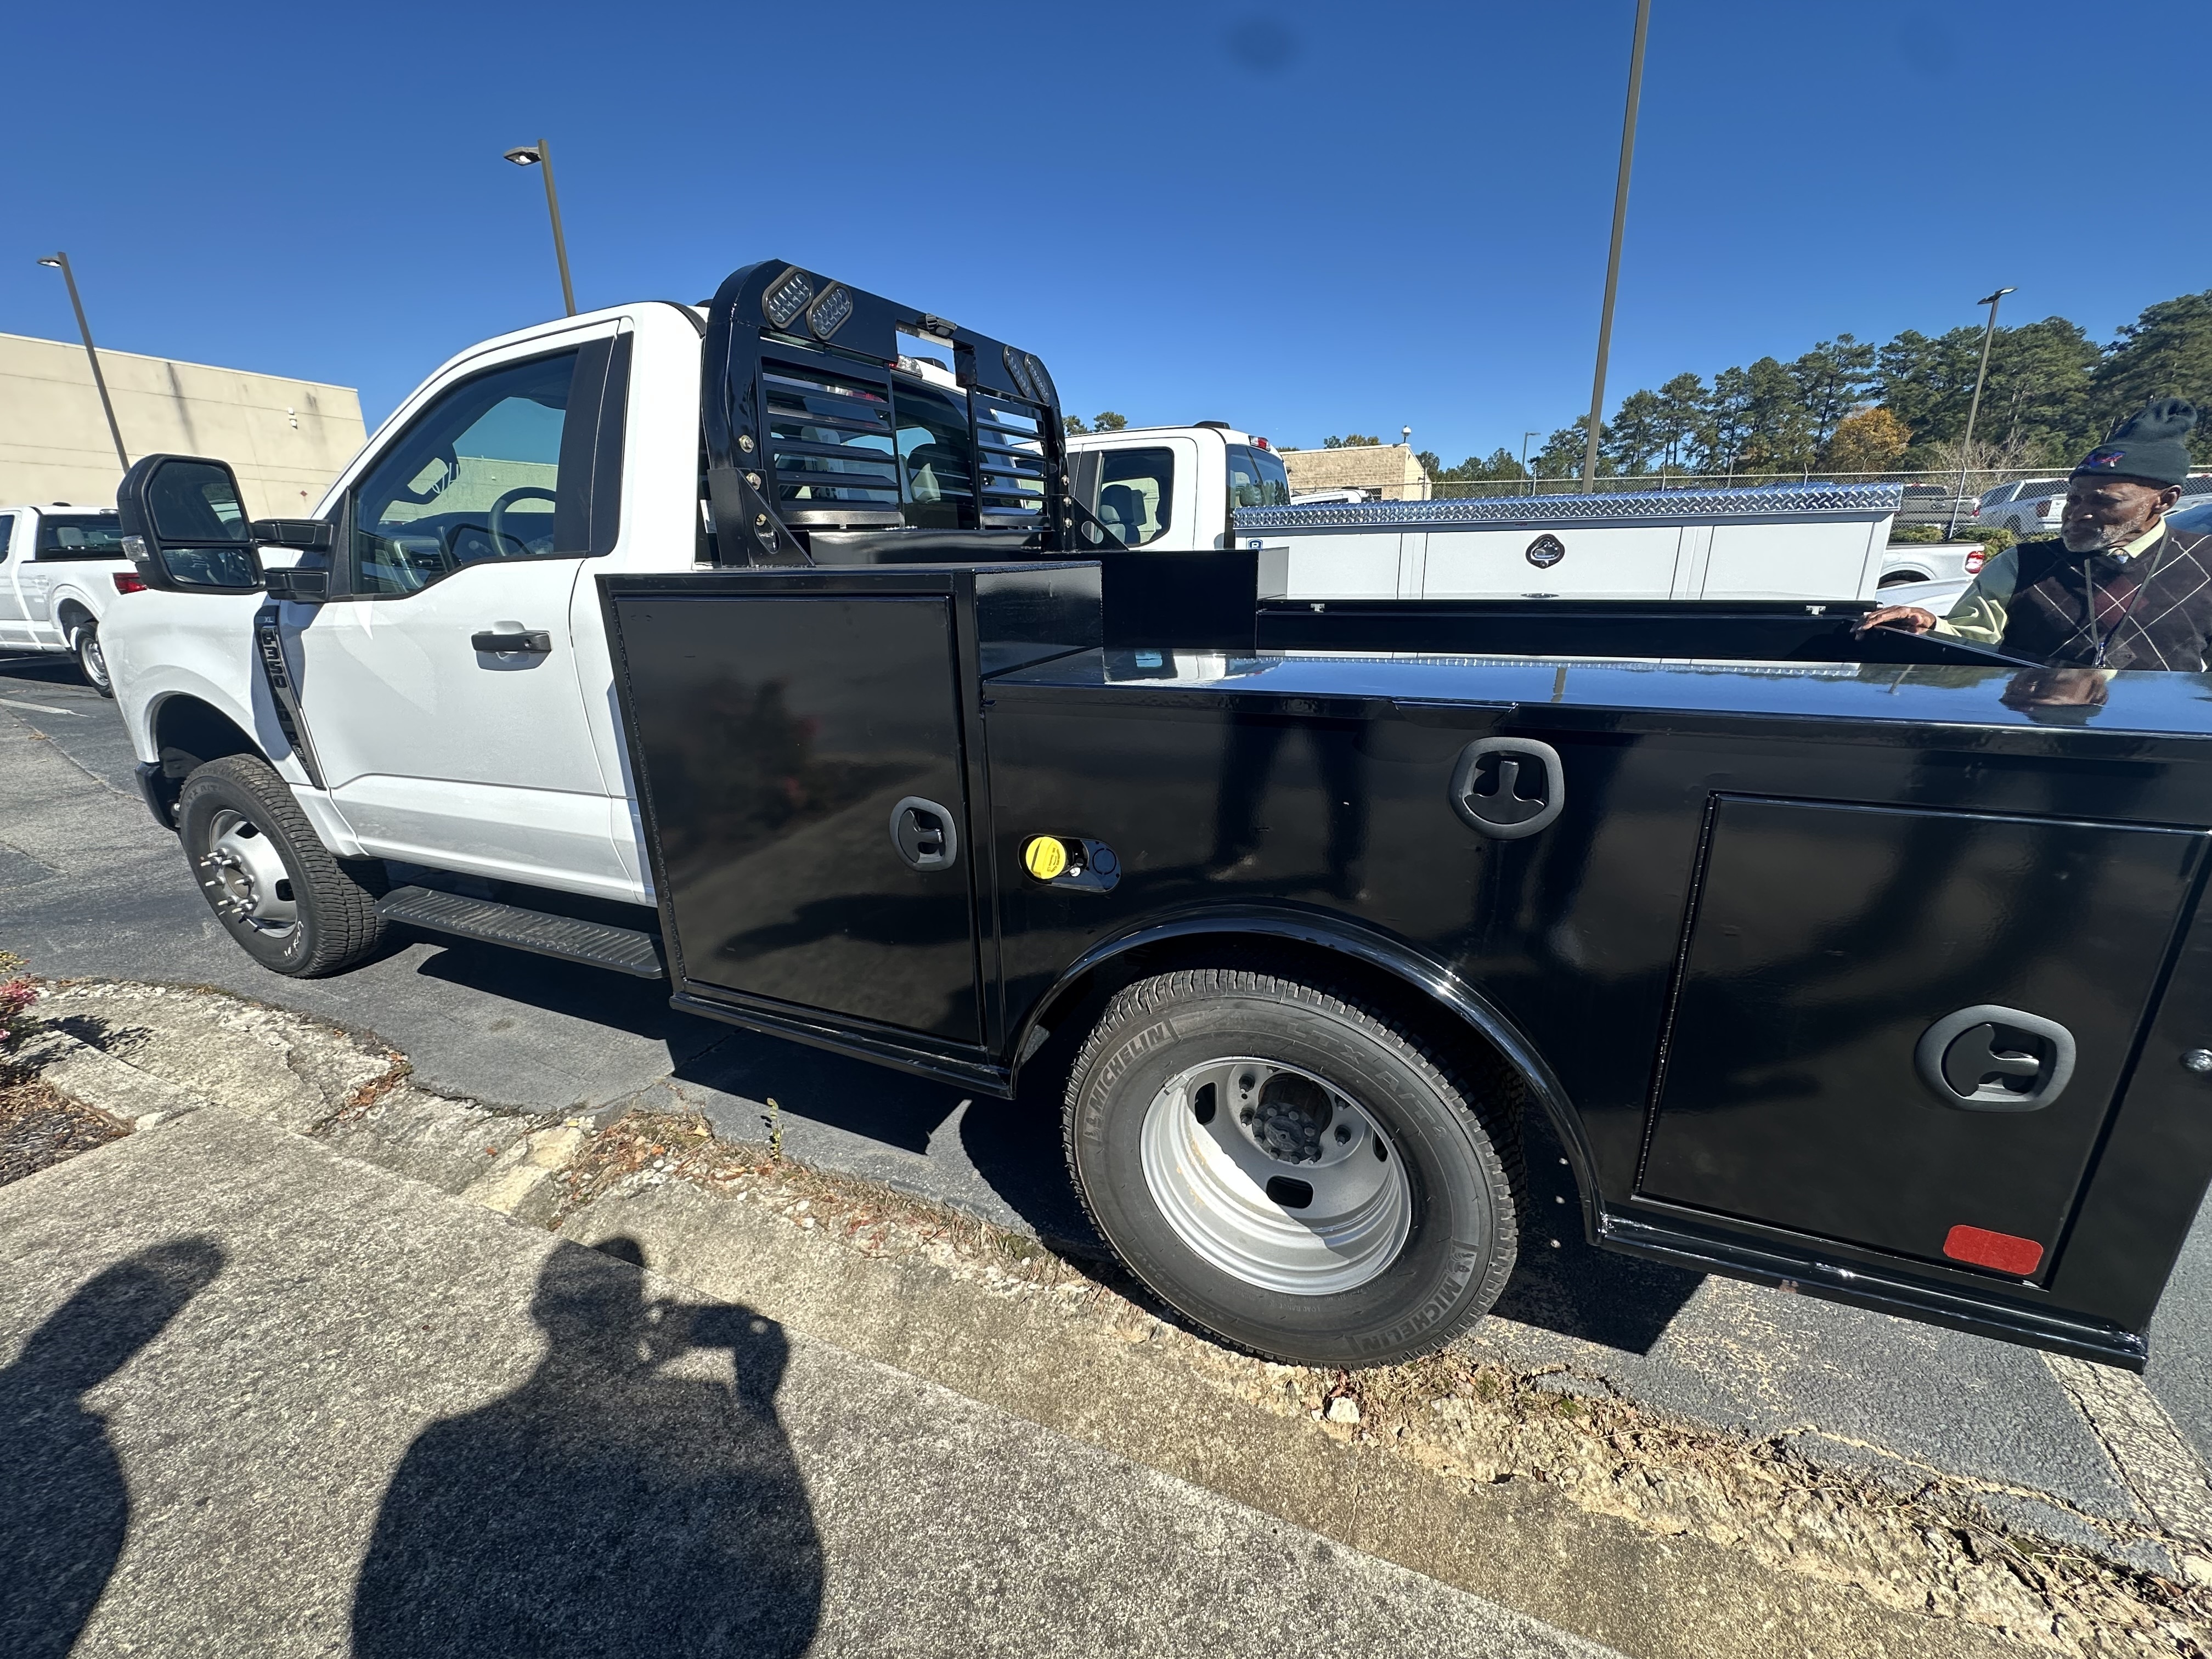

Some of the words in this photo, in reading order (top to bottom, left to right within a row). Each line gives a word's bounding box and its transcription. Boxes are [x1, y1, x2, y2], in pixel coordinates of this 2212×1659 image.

[261, 628, 287, 688] F350
[1089, 1024, 1168, 1117] MICHELIN
[1286, 1022, 1365, 1065] LTX
[1361, 1276, 1463, 1351] MICHELIN
